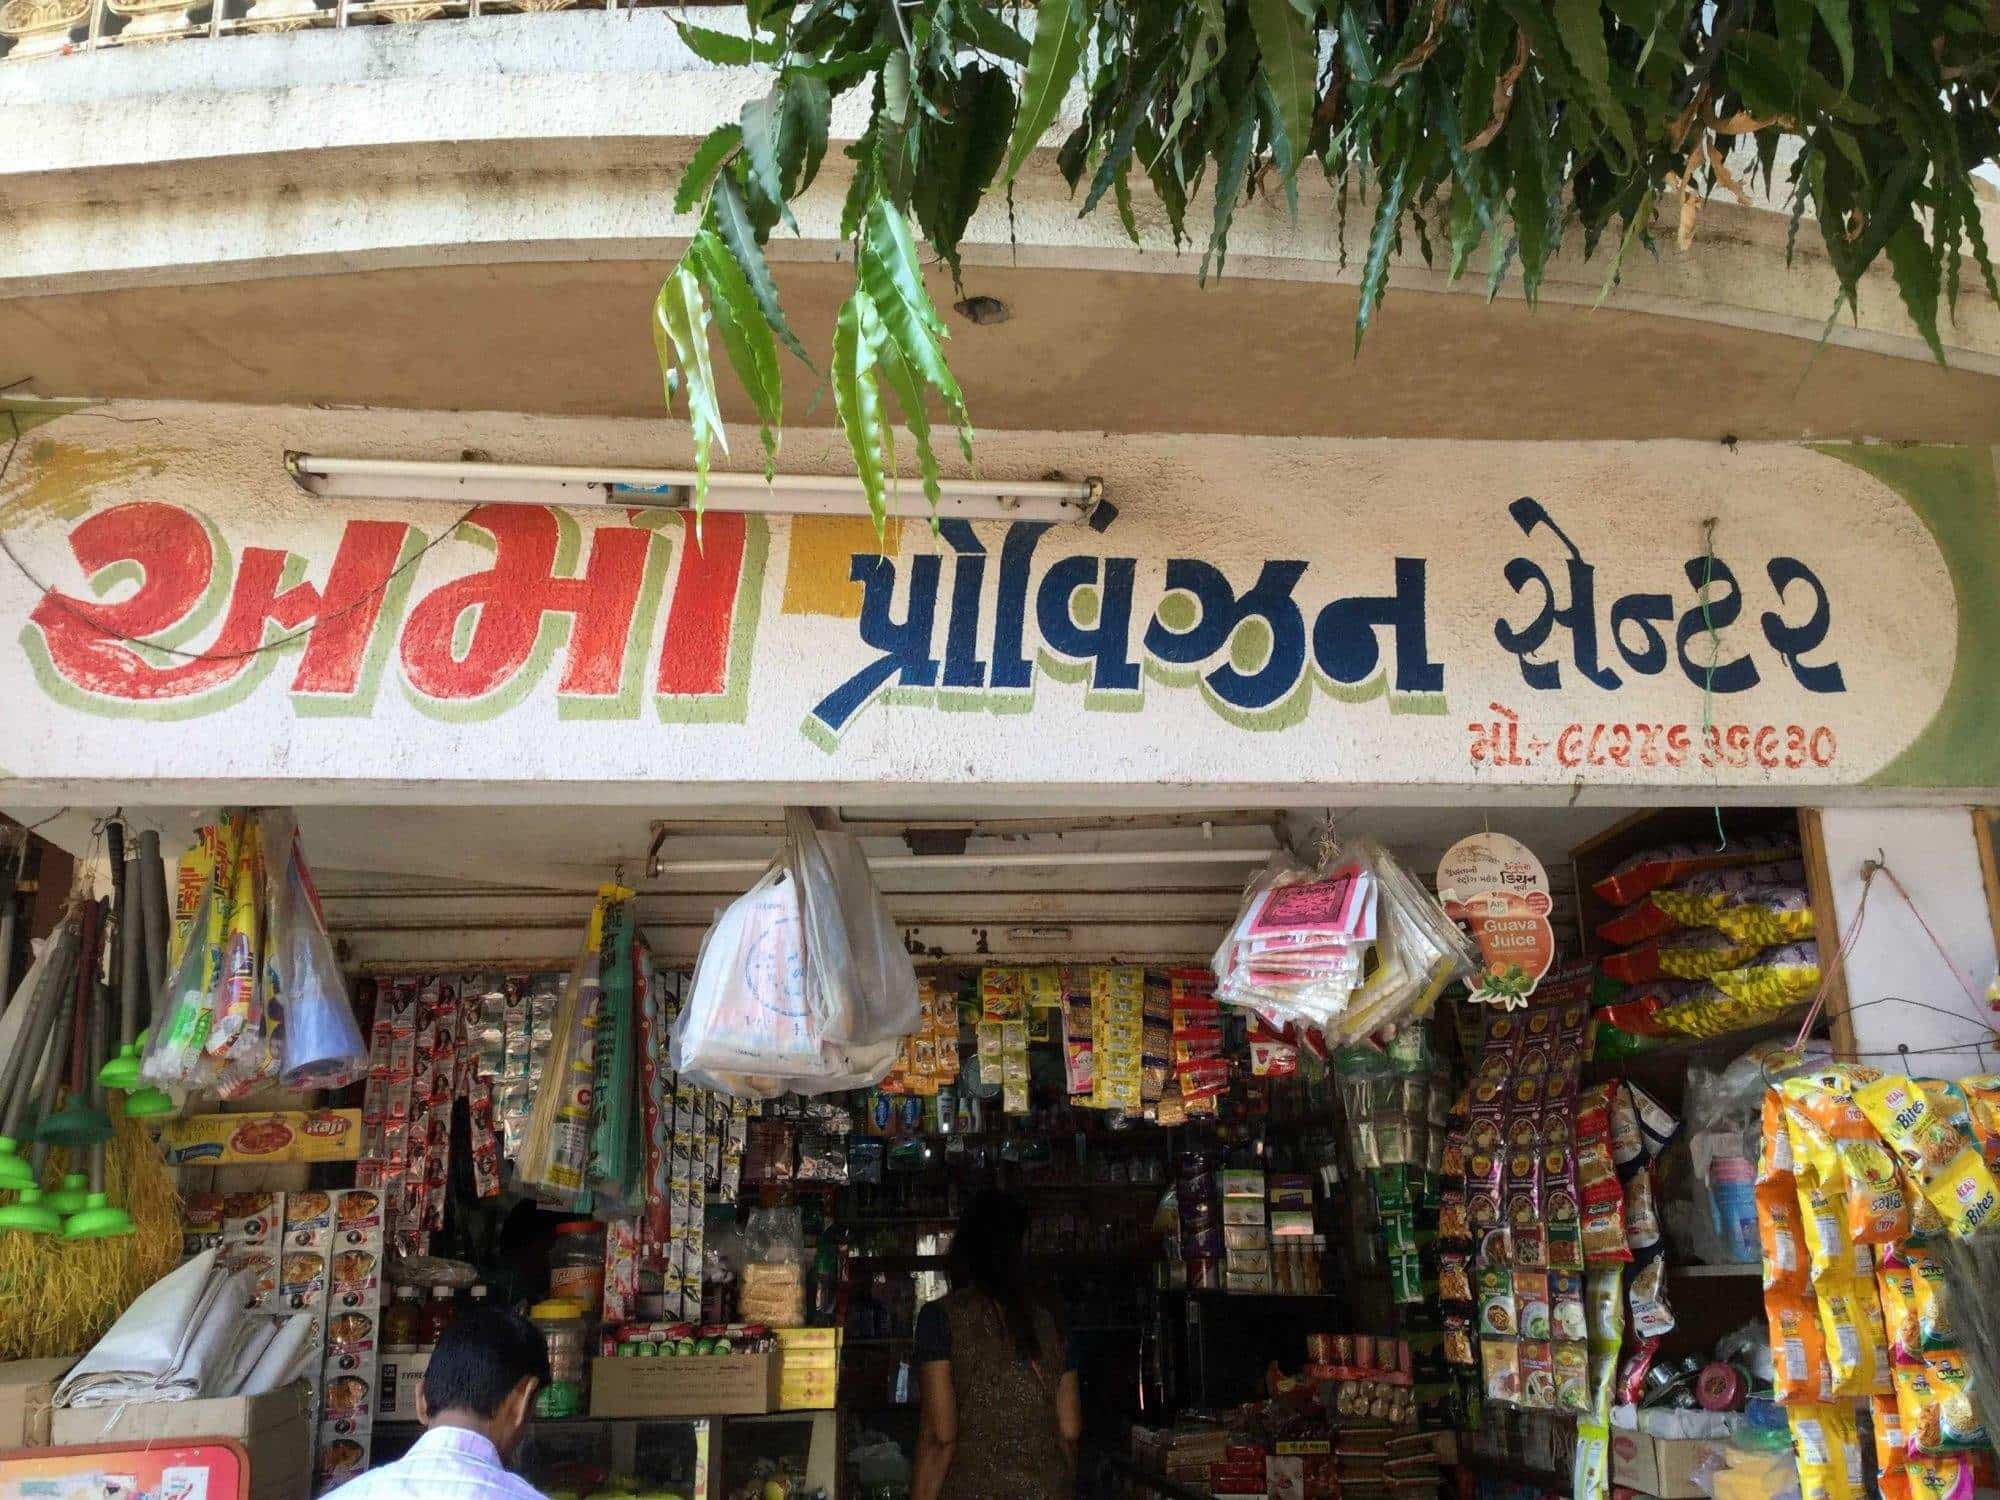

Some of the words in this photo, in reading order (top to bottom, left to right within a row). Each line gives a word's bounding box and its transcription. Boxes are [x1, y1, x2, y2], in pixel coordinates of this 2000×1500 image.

[808, 502, 1446, 718] પ્રોવિઝન
[1493, 496, 1847, 693] સેન્ટર
[1483, 919, 1537, 932] Guava
[1490, 934, 1536, 948] Juice
[1896, 1100, 1924, 1129] Bites
[1966, 1191, 1993, 1227] Bites
